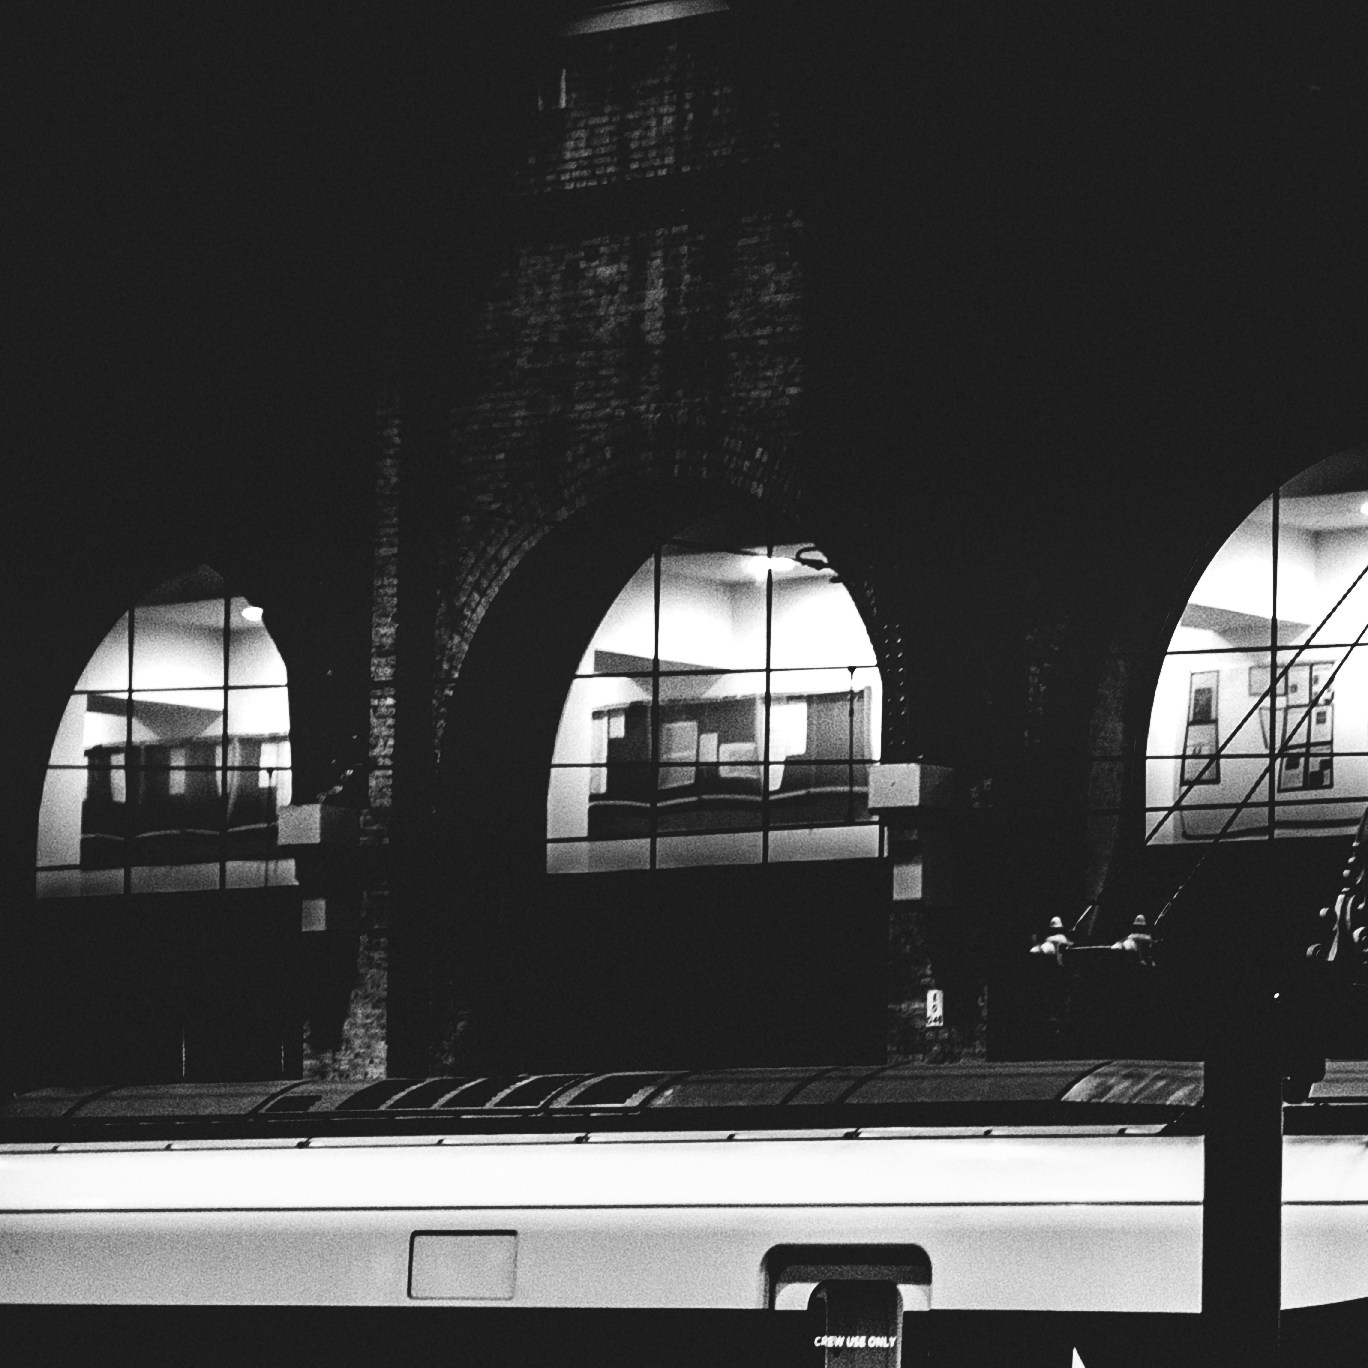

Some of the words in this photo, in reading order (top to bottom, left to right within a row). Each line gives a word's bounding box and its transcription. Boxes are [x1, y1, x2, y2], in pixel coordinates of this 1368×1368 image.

[814, 1335, 845, 1347] CREW
[846, 1335, 866, 1347] USE
[868, 1335, 897, 1347] ONLY
